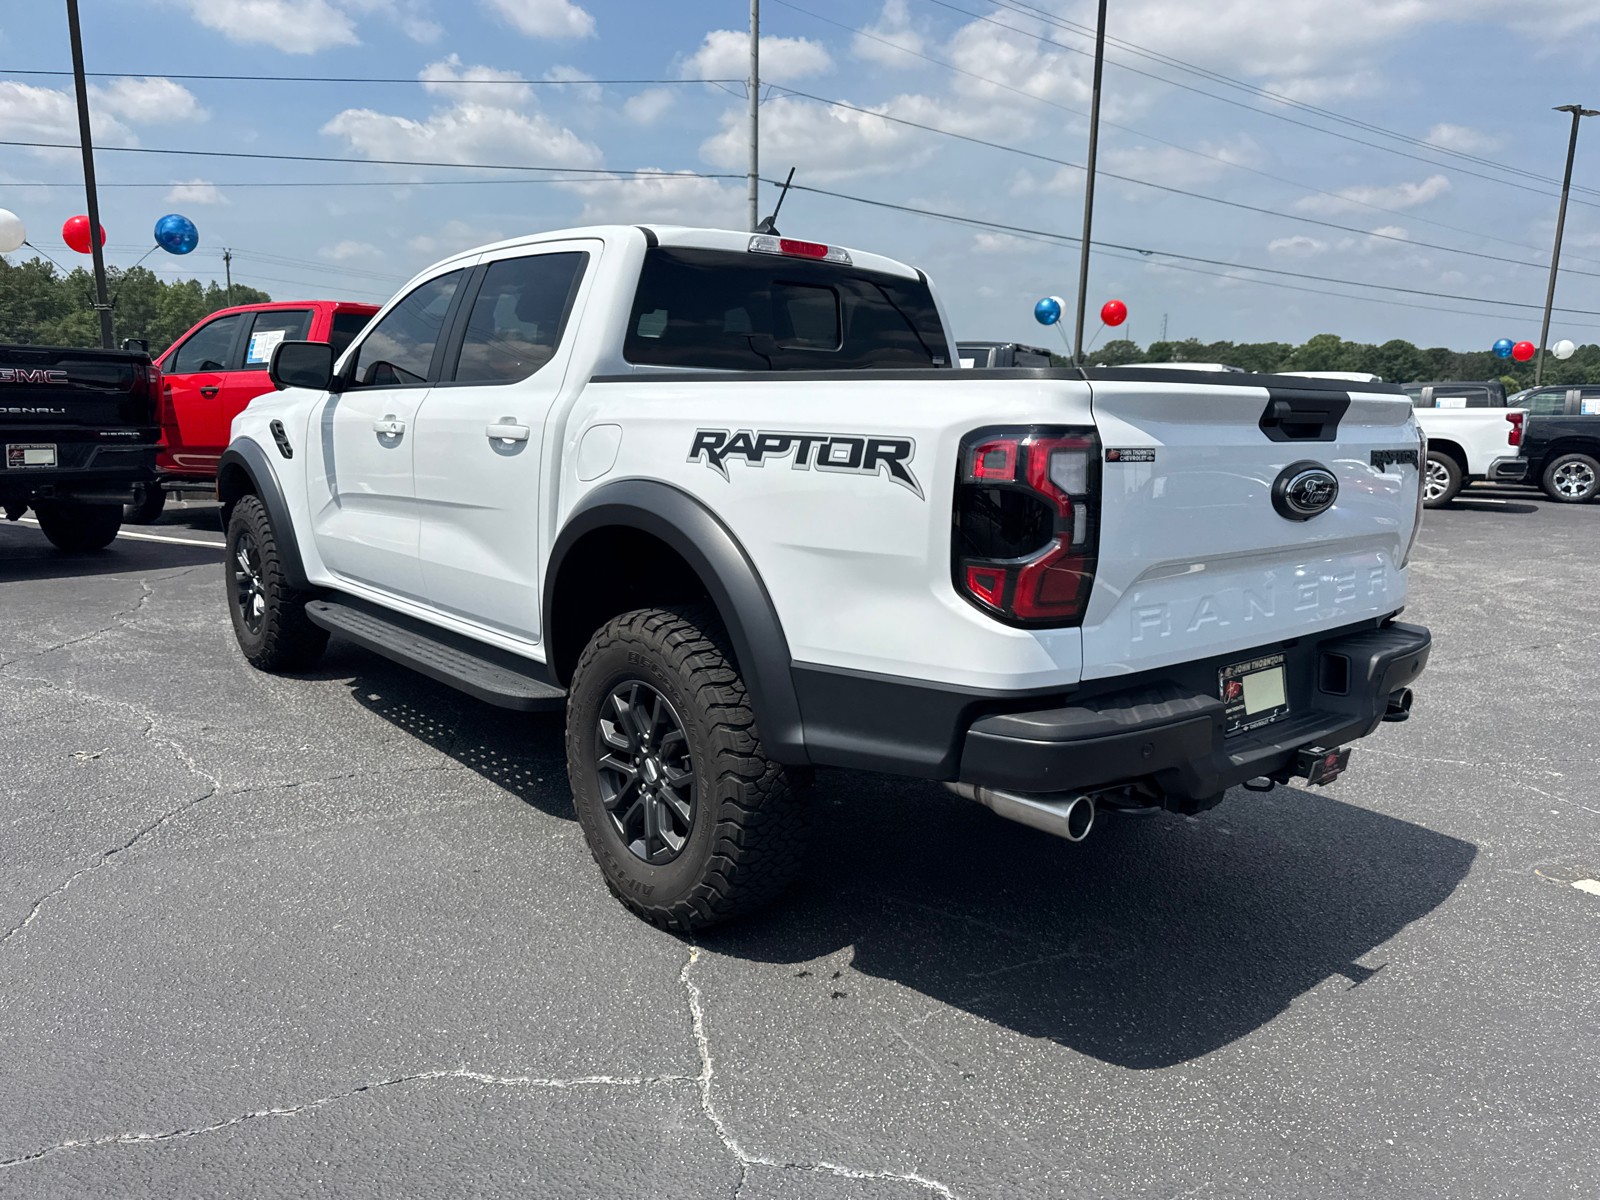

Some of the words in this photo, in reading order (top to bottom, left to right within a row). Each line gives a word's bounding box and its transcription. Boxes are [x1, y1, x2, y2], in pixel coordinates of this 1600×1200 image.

[0, 367, 68, 384] GMC
[685, 427, 925, 502] RAPTOR
[1370, 449, 1419, 473] RAPTOR
[1300, 479, 1333, 504] Ford
[1130, 564, 1388, 642] RANGER
[1233, 663, 1251, 675] JOHN
[1251, 655, 1284, 669] THORNTON
